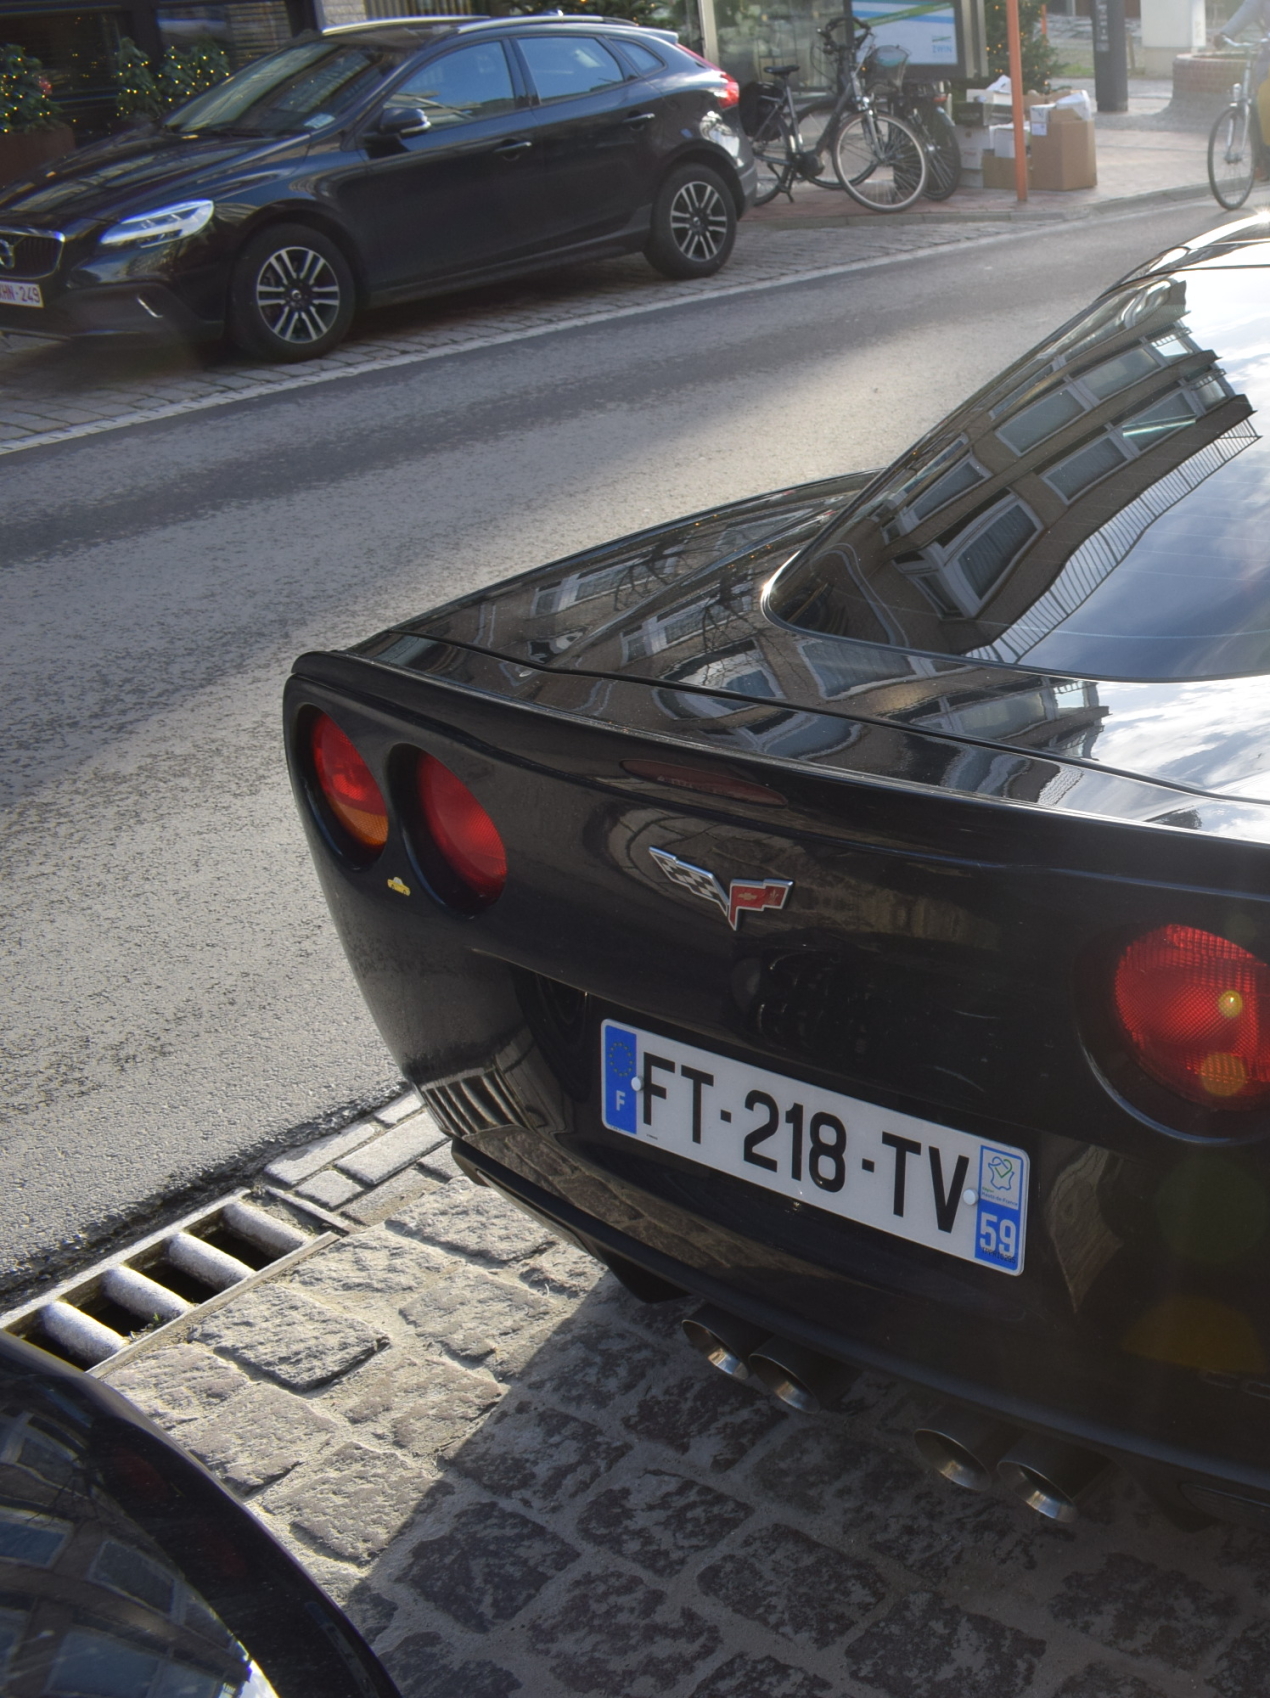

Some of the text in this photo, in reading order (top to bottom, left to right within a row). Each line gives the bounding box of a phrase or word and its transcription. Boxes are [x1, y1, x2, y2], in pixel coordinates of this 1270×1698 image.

[615, 1090, 626, 1112] F
[642, 1051, 970, 1234] FT-218-TV
[979, 1211, 1017, 1258] 59
